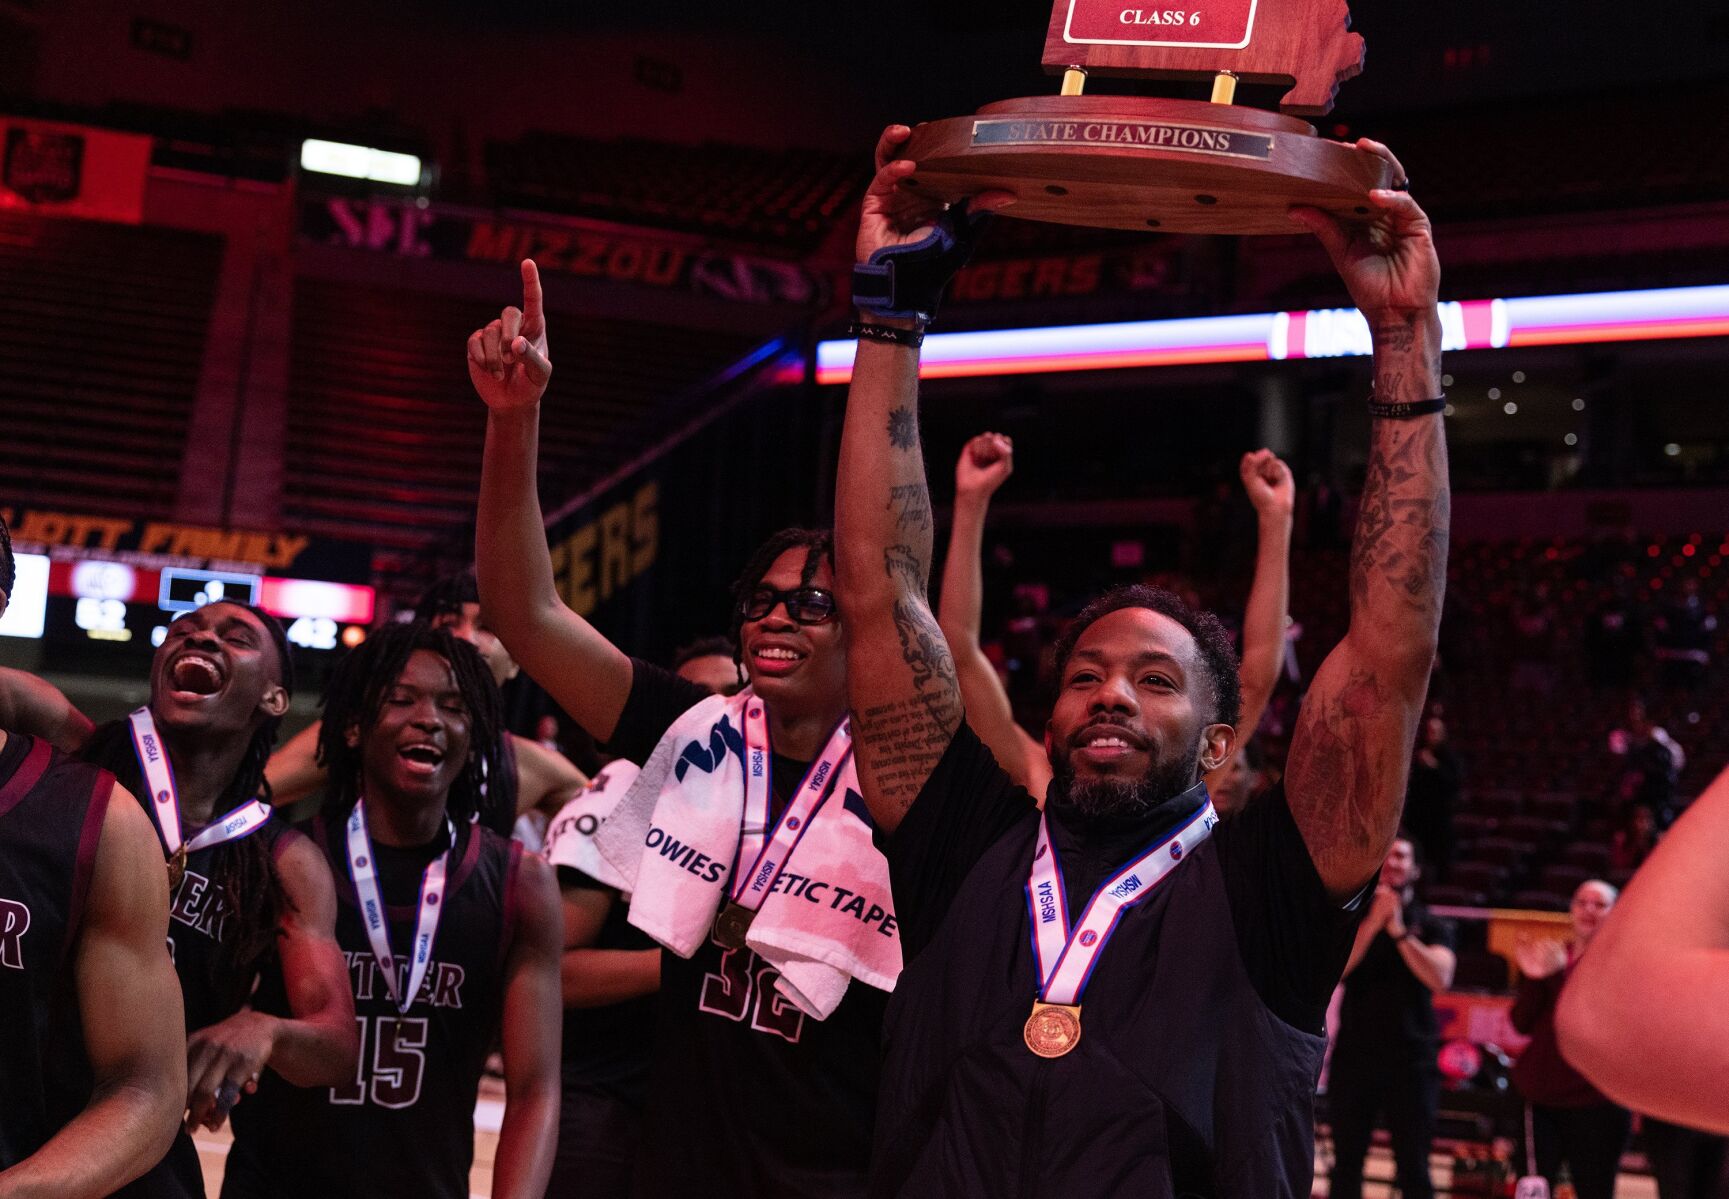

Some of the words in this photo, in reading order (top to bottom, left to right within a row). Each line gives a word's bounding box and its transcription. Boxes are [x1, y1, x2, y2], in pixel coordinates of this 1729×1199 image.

[1119, 9, 1185, 26] CLASS
[1189, 10, 1201, 27] 6
[1007, 121, 1077, 141] STATE
[1083, 123, 1231, 151] CHAMPIONS
[467, 222, 688, 286] MIZZOU
[950, 254, 1103, 303] IGERS
[138, 521, 311, 568] FAMILY
[752, 746, 764, 778] MSHSAA
[808, 760, 832, 792] MSHSAA
[645, 823, 728, 884] OWIES
[753, 860, 776, 893] MSHSAA
[169, 870, 235, 943] ER
[770, 872, 830, 904] ETIC
[831, 886, 897, 938] TAPE
[1037, 880, 1057, 924] MSHSAA
[1108, 873, 1143, 900] MSHSAA
[365, 897, 382, 930] MSHSAA
[343, 951, 465, 1009] TTER
[698, 925, 805, 1044] 32
[328, 1015, 429, 1110] 15
